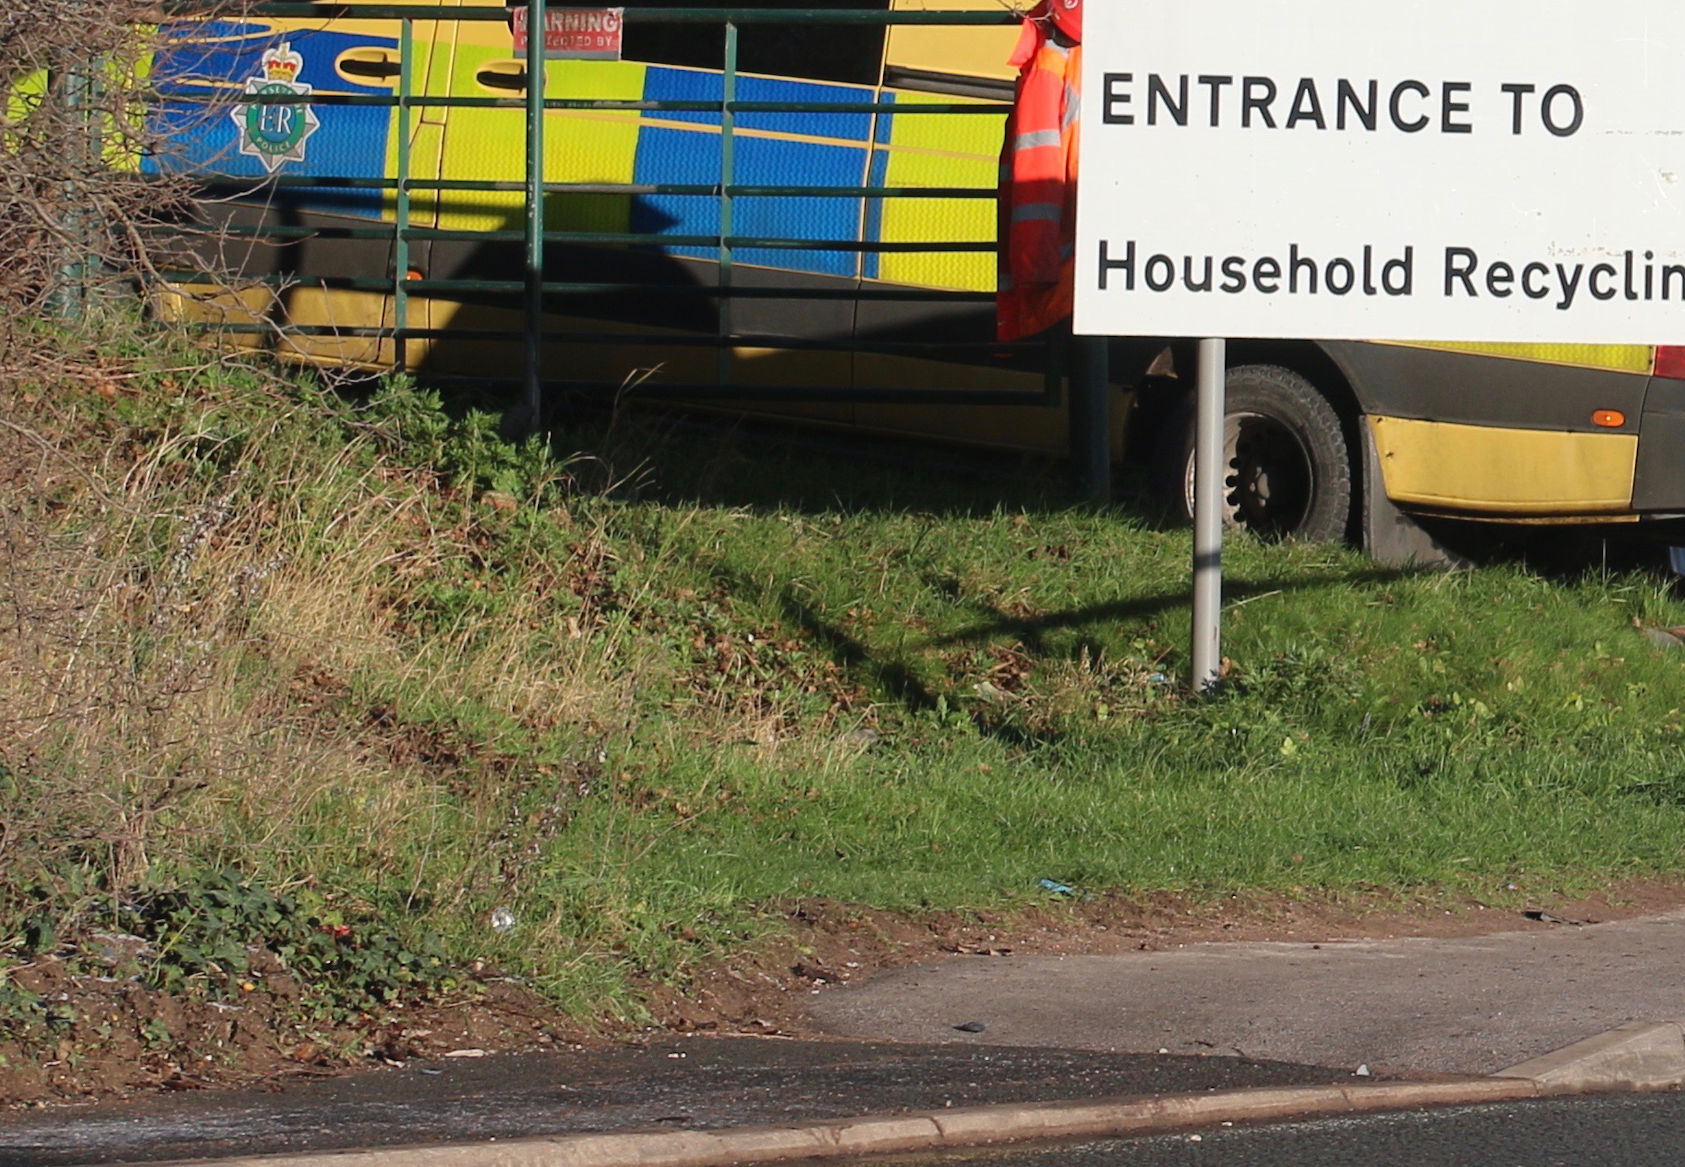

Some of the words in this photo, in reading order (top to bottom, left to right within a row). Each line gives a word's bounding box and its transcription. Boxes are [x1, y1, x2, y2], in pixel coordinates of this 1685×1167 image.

[597, 36, 614, 47] BY
[1102, 72, 1473, 134] ENTRANCE
[1501, 83, 1585, 138] TO
[1097, 239, 1414, 297] Household
